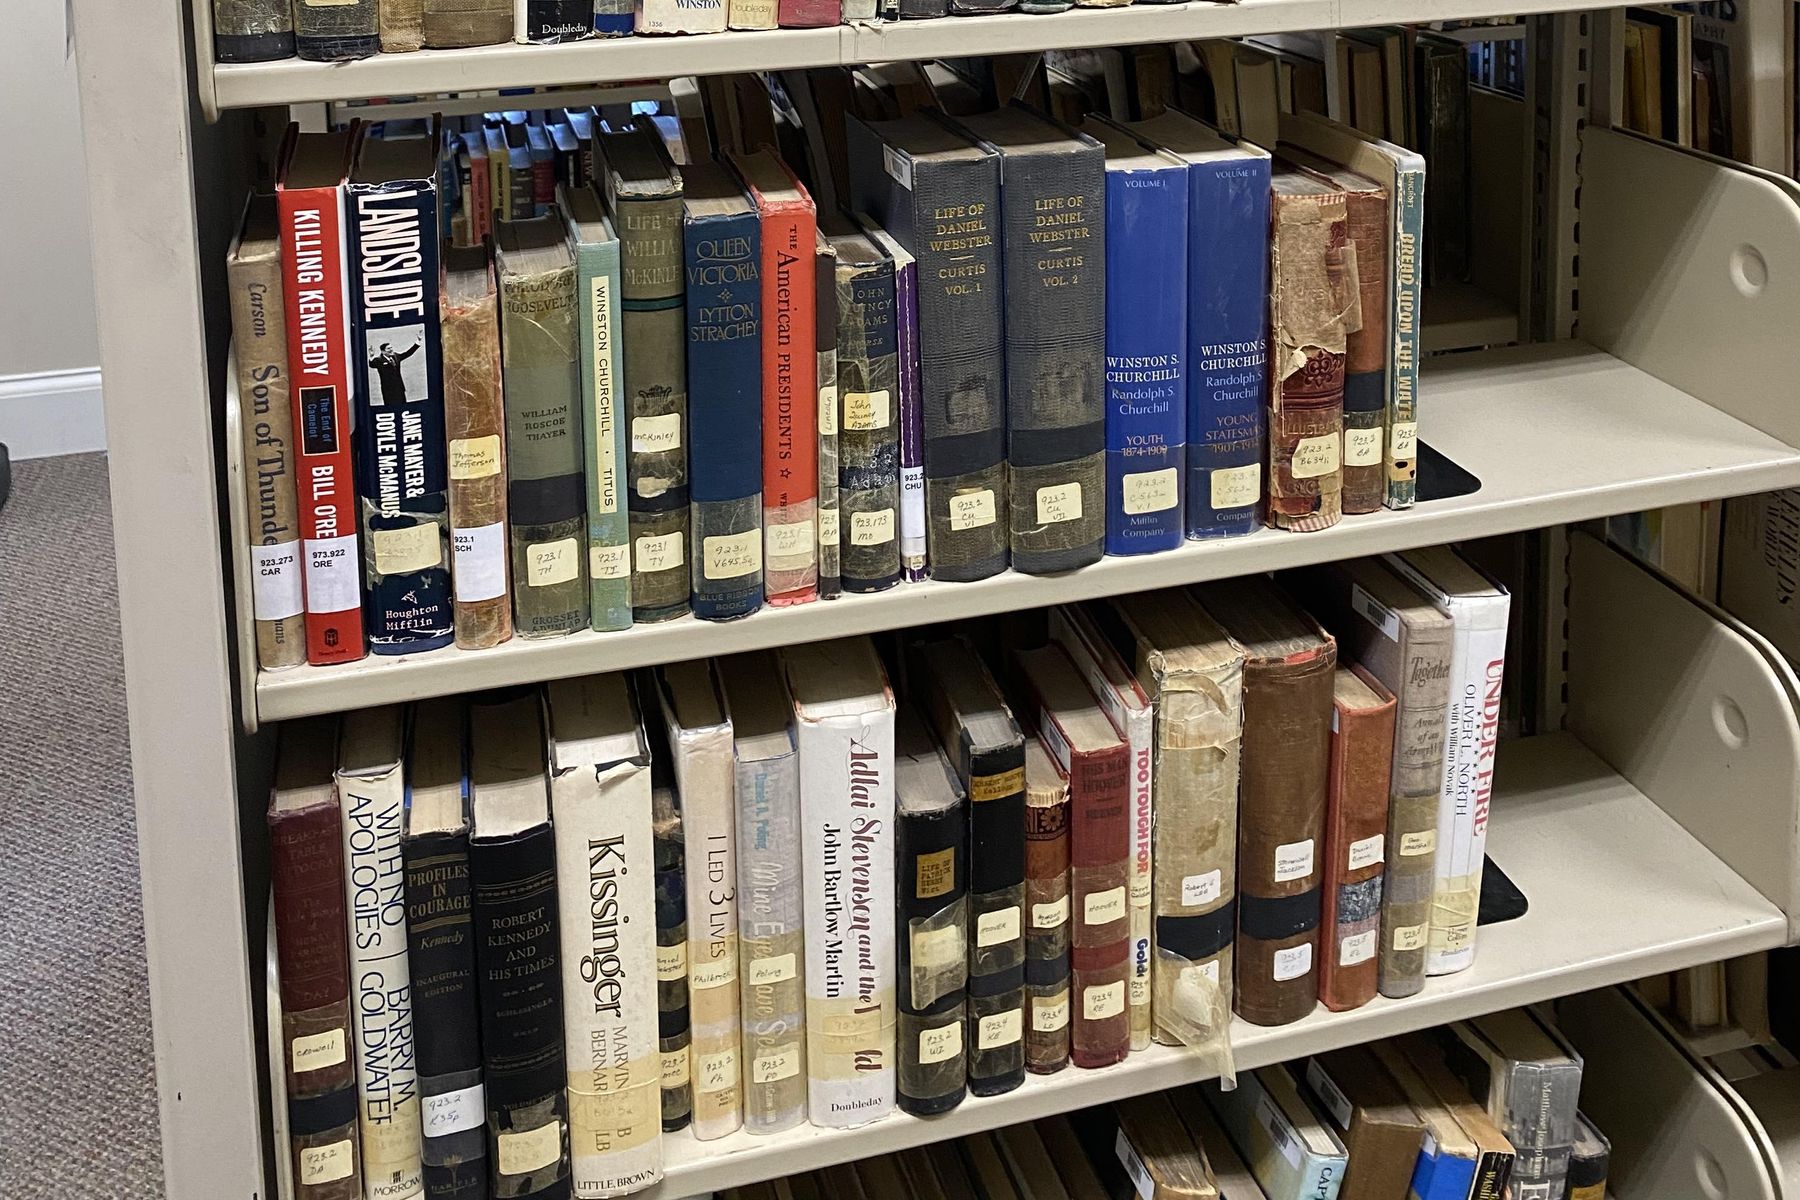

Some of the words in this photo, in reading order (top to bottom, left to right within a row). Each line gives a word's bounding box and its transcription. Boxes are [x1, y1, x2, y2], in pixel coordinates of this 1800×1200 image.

[676, 0, 722, 9] WINSTON
[542, 23, 588, 35] Doubleday
[937, 220, 986, 235] DANIEL
[1036, 212, 1085, 227] DANIEL
[293, 209, 324, 284] KILLING
[931, 235, 992, 251] WEBSTER
[1029, 227, 1090, 243] WEBSTER
[358, 190, 424, 322] LANDSLIDE
[1038, 256, 1083, 270] CURTIS
[687, 260, 759, 285] VICTORIA
[939, 264, 986, 278] CURTIS
[777, 250, 799, 346] American
[596, 285, 608, 351] WINSTON
[699, 302, 755, 323] LYTTON
[298, 290, 329, 375] KENNEDY
[691, 321, 758, 342] STRACHEY
[1200, 354, 1267, 370] CHURCHILL
[1106, 368, 1180, 383] CHURCHILL
[599, 358, 612, 437] CHURCHILL
[1213, 386, 1259, 401] Churchill
[521, 405, 567, 419] WILLIAM
[778, 352, 792, 461] PRESIDENTS
[1119, 402, 1169, 415] Churchill
[375, 412, 397, 454] DOYLE
[525, 417, 566, 431] ROSCOE
[526, 429, 566, 441] THAYER
[378, 454, 401, 519] McMANUS
[603, 467, 614, 507] TITUS
[261, 556, 294, 567] 923.273
[312, 549, 345, 559] 973.922
[313, 559, 333, 568] ORE
[261, 568, 281, 576] CAR
[386, 604, 439, 620] Houghton
[386, 617, 433, 631] Mifflin
[1461, 683, 1477, 748] OLIVER
[1479, 658, 1504, 762] UNDER
[1136, 747, 1149, 782] TOO
[1460, 747, 1471, 759] L.
[1456, 762, 1471, 818] NORTH
[1136, 783, 1149, 835] TOUGH
[1473, 769, 1494, 837] FIRE
[375, 802, 403, 879] WITH
[823, 823, 842, 866] John
[1137, 835, 1149, 875] FOR
[347, 793, 381, 949] APOLOGIES
[408, 864, 469, 887] PROFILES
[752, 862, 783, 914] Mine
[380, 884, 405, 927] NO
[409, 895, 471, 918] COURAGE
[824, 870, 843, 936] Bartlow
[492, 907, 544, 929] ROBERT
[580, 834, 630, 1018] Kissinger
[420, 931, 464, 949] Kennedy
[488, 921, 552, 946] KENNEDY
[506, 946, 536, 962] AND
[416, 969, 470, 986] INAUGURAL
[825, 938, 845, 998] Martin
[424, 983, 463, 998] EDITION
[388, 984, 414, 1075] BARRY
[613, 1025, 630, 1089] MARVIN
[392, 1079, 415, 1111] M.
[831, 1095, 883, 1113] Doubleday
[374, 1175, 421, 1196] MORROW
